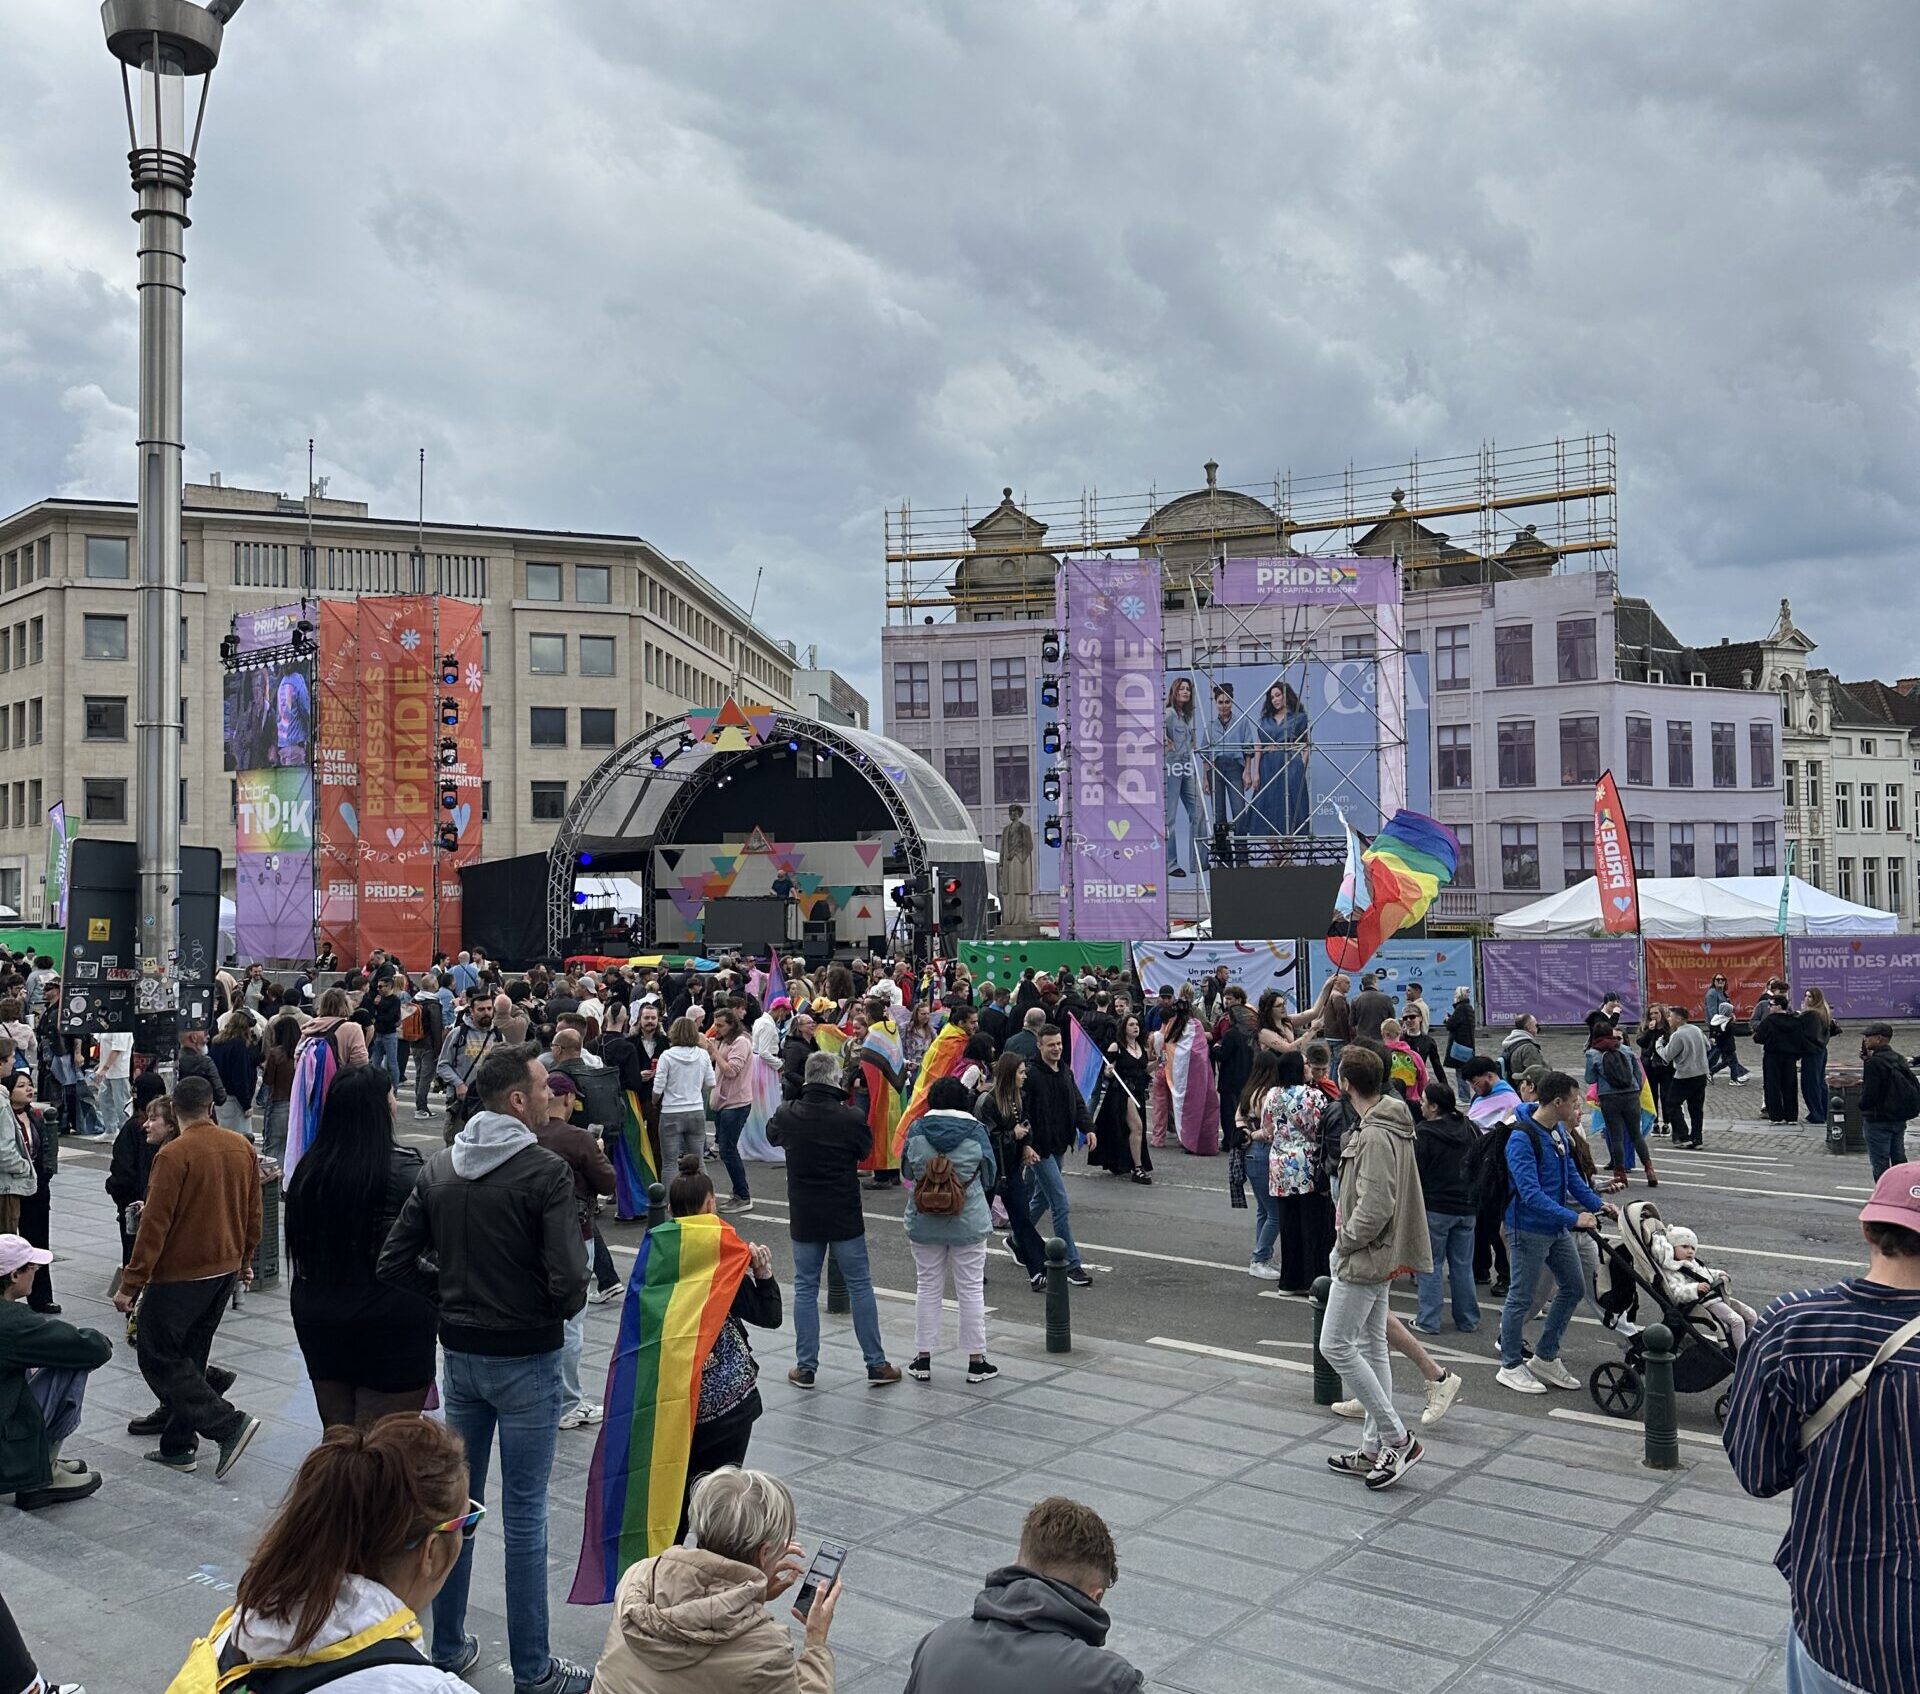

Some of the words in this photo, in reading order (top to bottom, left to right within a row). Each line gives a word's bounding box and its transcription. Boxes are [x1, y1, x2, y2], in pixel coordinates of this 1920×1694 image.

[1257, 567, 1331, 585] PRIDE
[254, 615, 286, 636] PRIDE
[322, 710, 352, 722] TIM
[1078, 638, 1103, 806] BRUSSELS
[1115, 637, 1155, 805] PRIDE
[323, 724, 352, 734] GET
[365, 667, 384, 816] BRUSSELS
[394, 666, 426, 815] PRIDE
[322, 749, 345, 760] WE
[324, 761, 357, 773] SHIN
[441, 762, 467, 774] SHINE
[323, 774, 357, 785] BRIG
[365, 886, 407, 897] PRIDE
[442, 884, 462, 897] PRID
[1083, 885, 1136, 897] PRIDE
[1656, 956, 1718, 969] RAINBOW
[1721, 956, 1775, 968] VILLAGE
[1799, 955, 1850, 969] MONT
[1853, 955, 1886, 968] DES
[1889, 953, 1920, 968] ART
